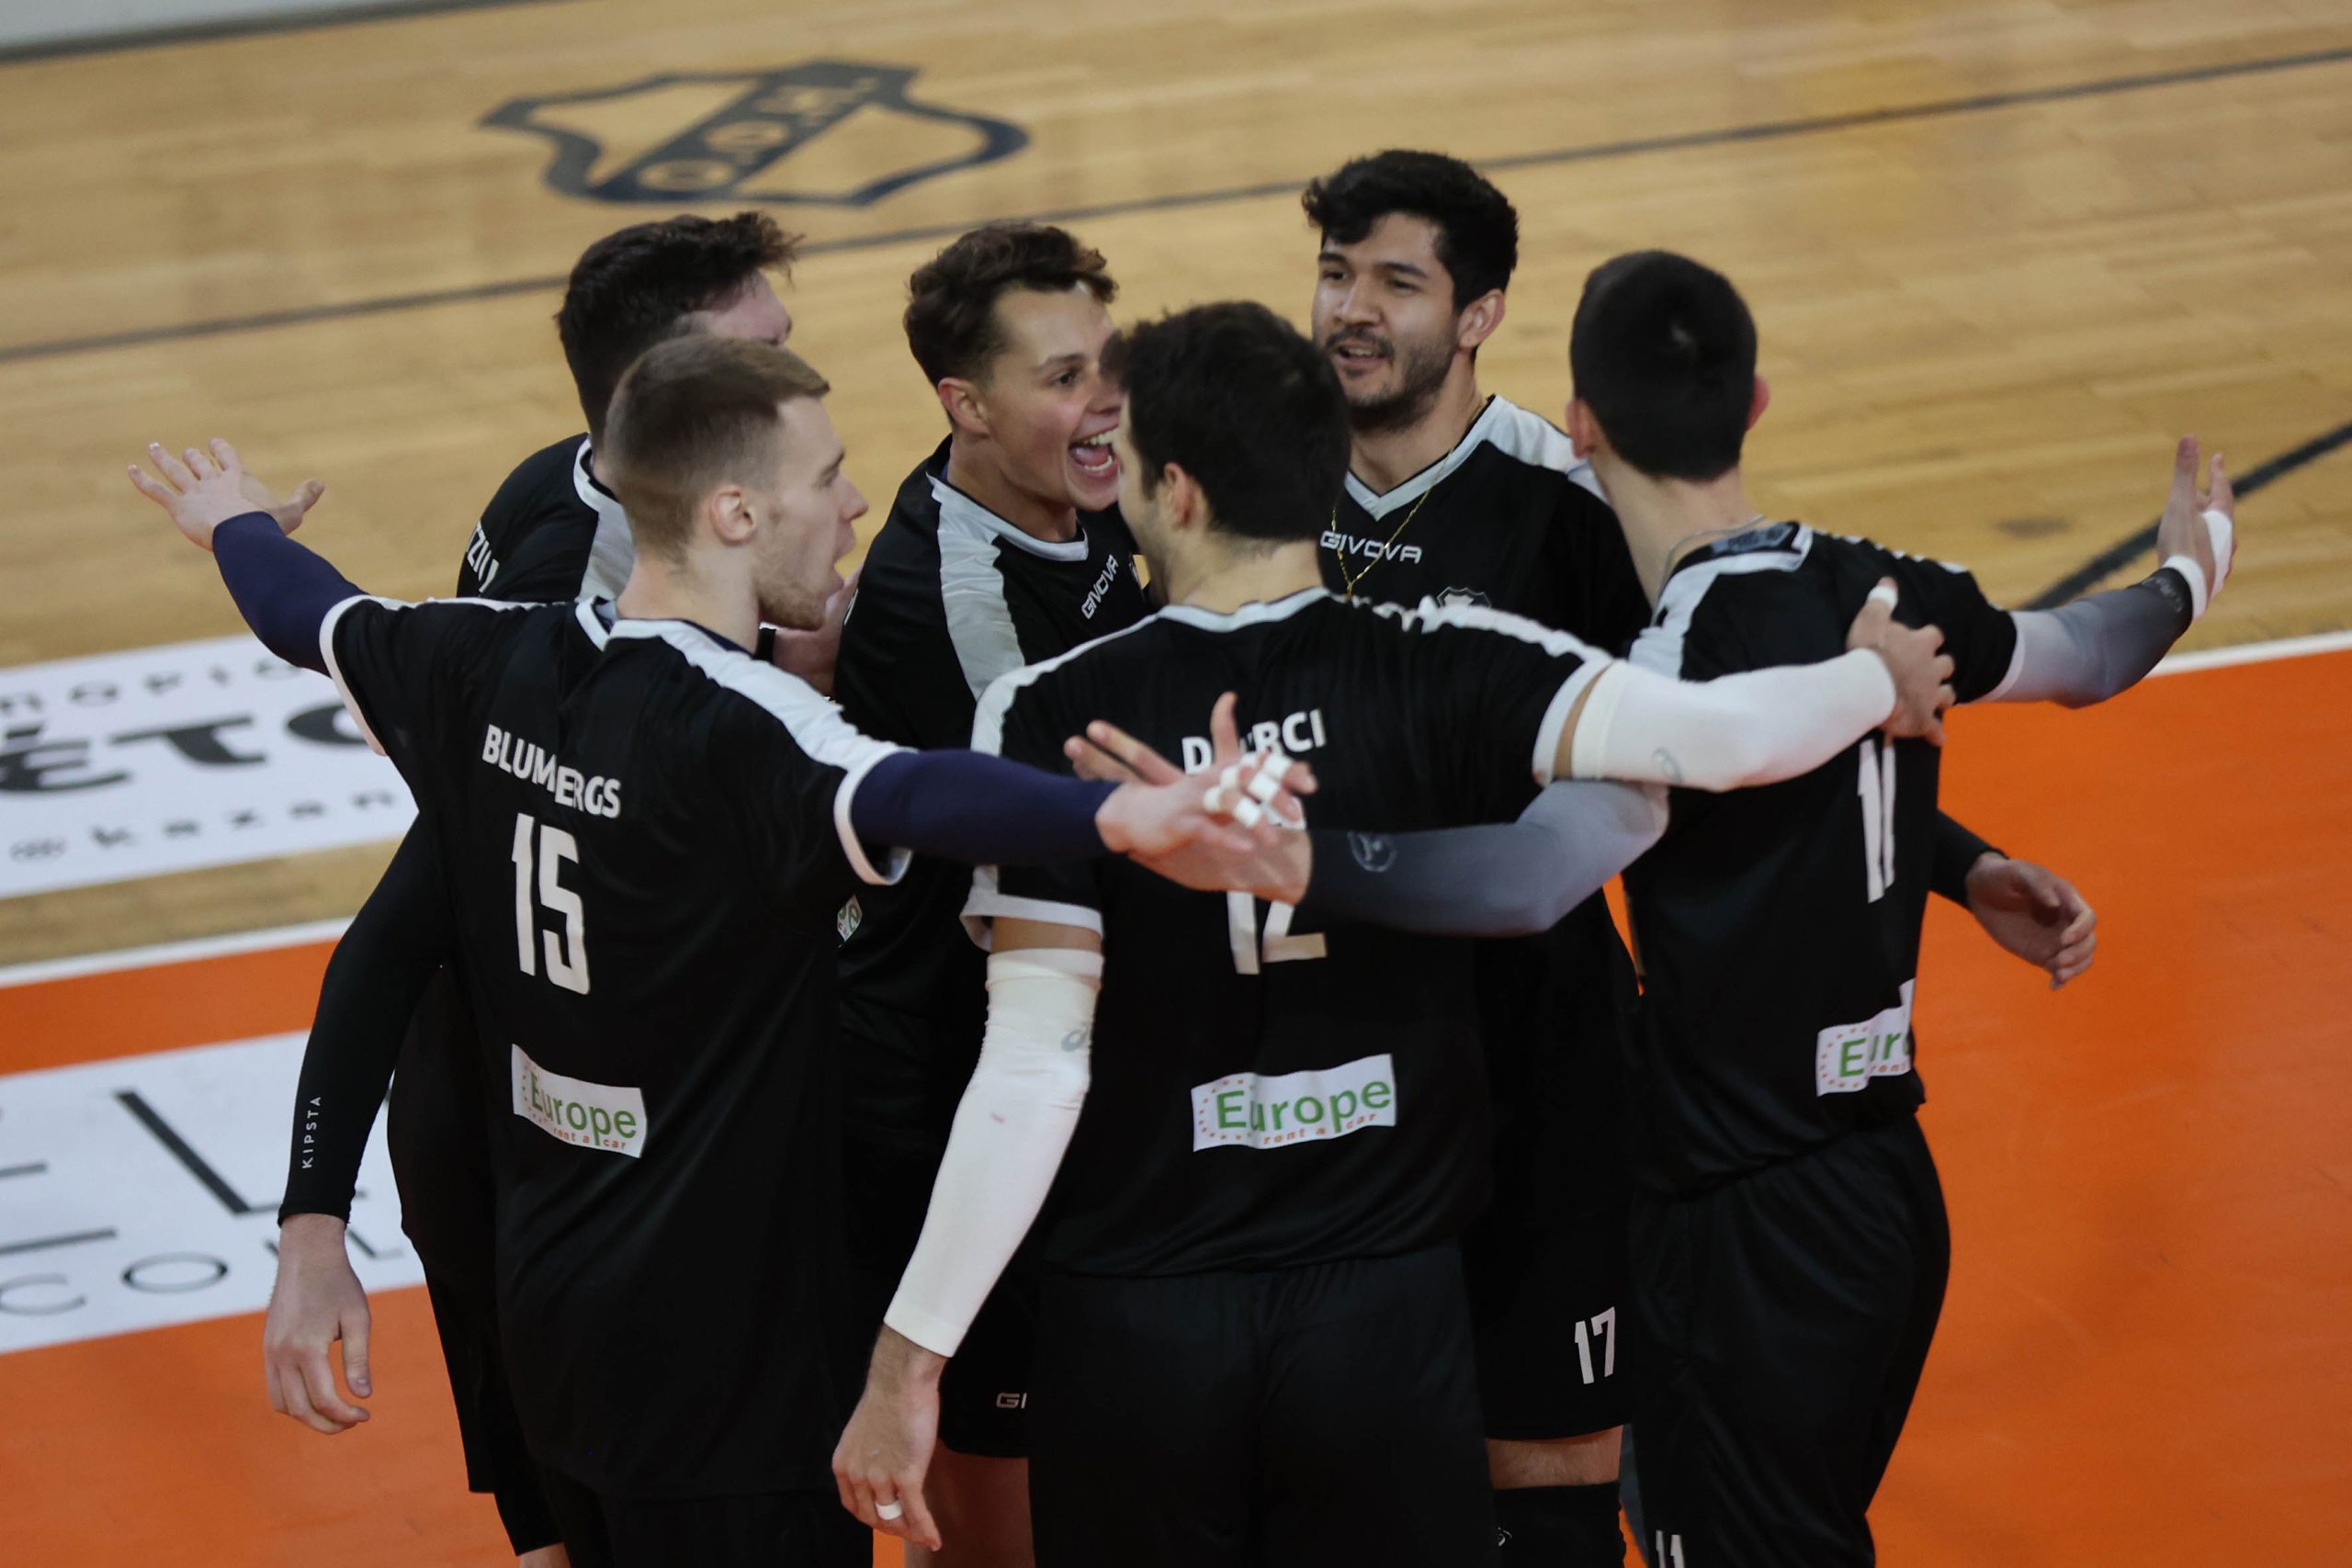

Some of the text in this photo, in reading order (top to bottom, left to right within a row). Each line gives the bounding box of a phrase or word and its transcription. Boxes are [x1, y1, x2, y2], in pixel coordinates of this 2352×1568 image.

[1319, 530, 1423, 565] GIVOVA
[1080, 553, 1119, 620] GIVOVA
[511, 812, 592, 996] 15
[301, 1096, 322, 1169] KIPSTA
[530, 1071, 638, 1146] Europe
[553, 1127, 628, 1150] rent a car
[1216, 1080, 1392, 1134] Europe
[1263, 1127, 1306, 1145] rent
[1345, 1112, 1377, 1131] car
[1574, 1305, 1616, 1384] 17
